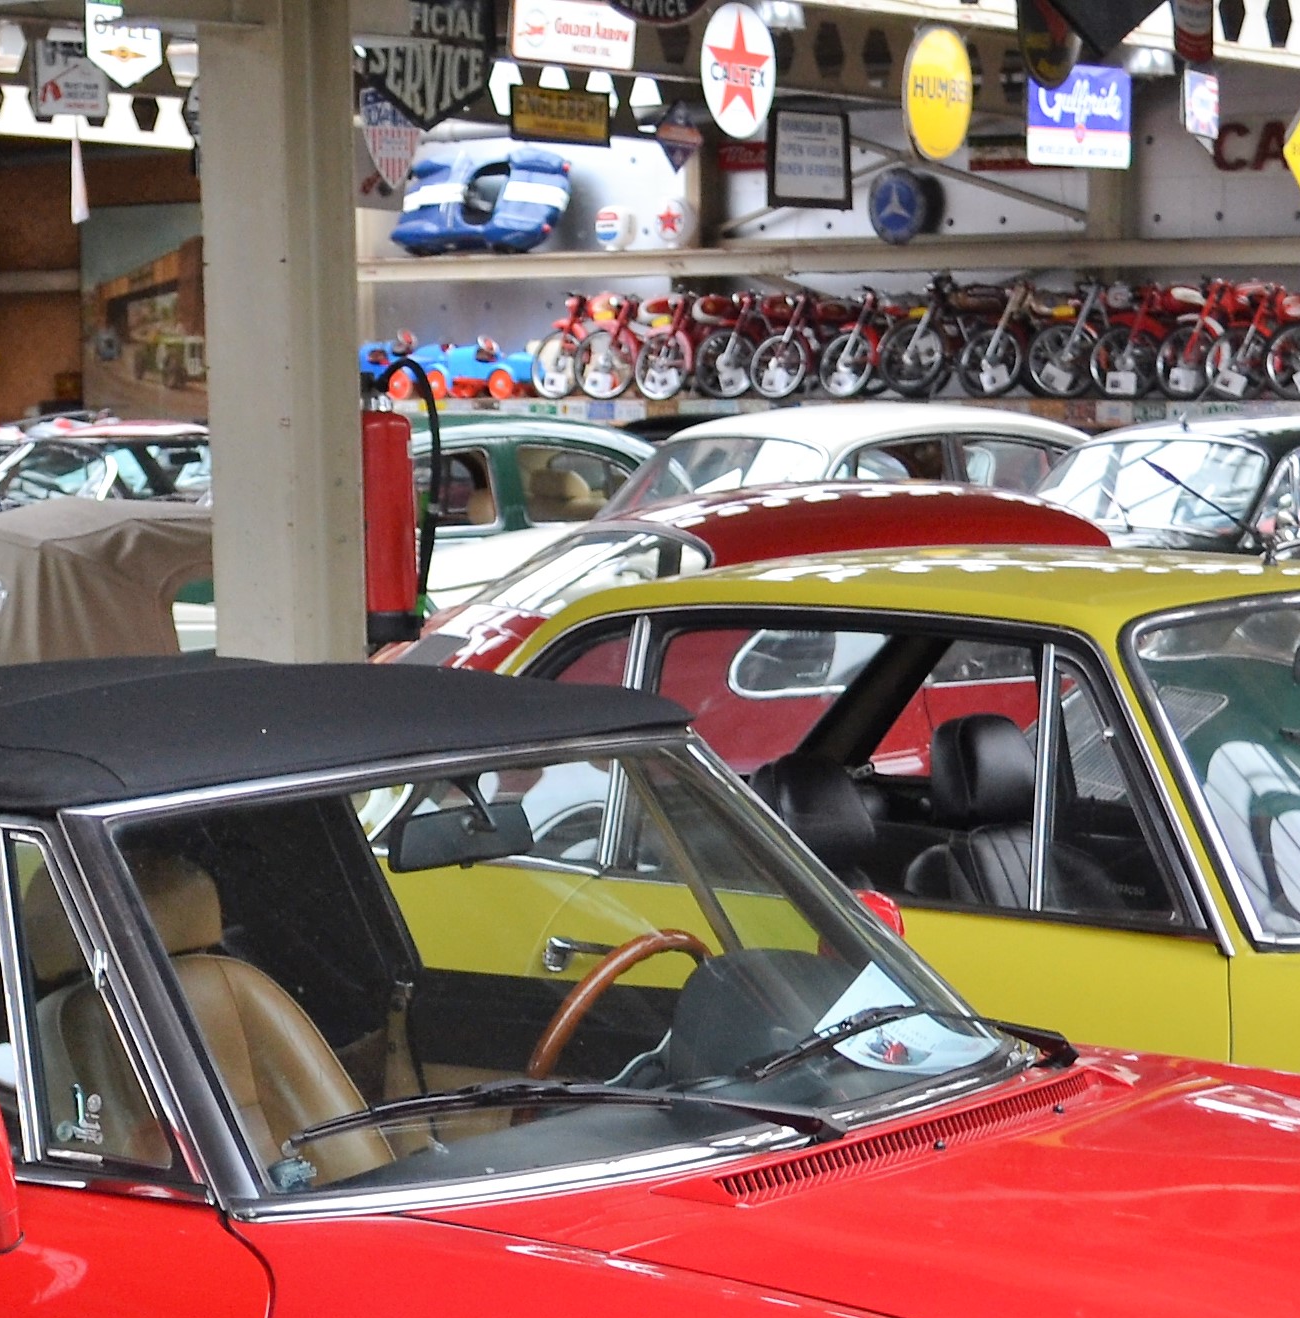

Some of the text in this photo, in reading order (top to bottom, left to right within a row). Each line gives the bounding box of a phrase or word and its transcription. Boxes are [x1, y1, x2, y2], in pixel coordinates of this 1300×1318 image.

[368, 42, 484, 122] SERVICE
[710, 61, 766, 88] CALTEX
[516, 89, 605, 121] ENGLEBERT
[1038, 79, 1123, 124] Gulfpride
